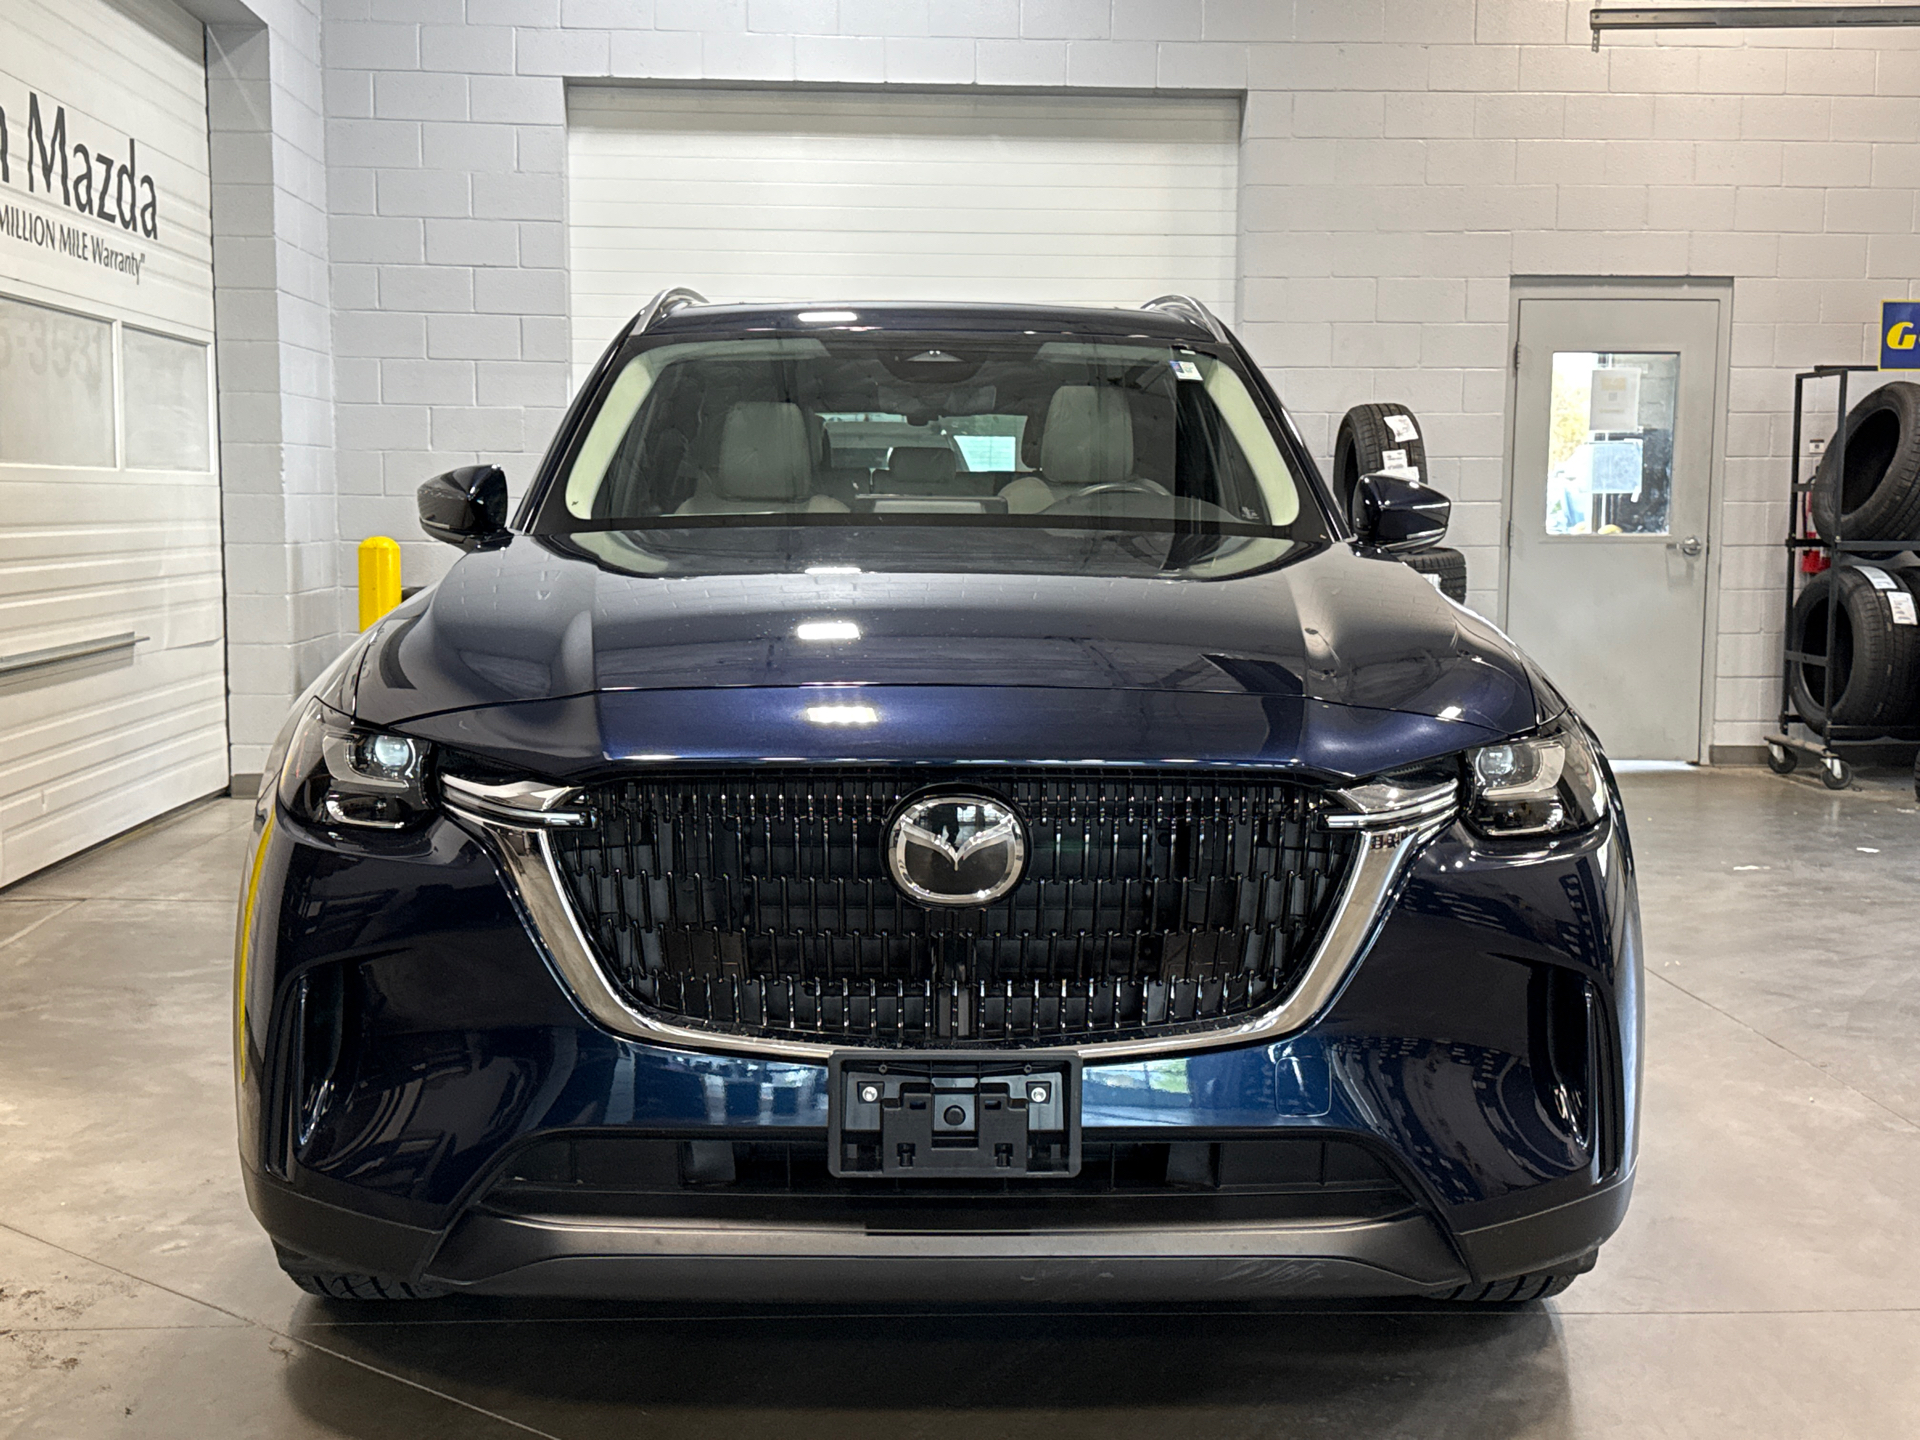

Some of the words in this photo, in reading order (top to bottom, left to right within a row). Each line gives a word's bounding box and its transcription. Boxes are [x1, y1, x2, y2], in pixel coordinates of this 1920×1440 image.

[27, 91, 158, 240] Mazda
[0, 204, 56, 251] MILLION
[59, 223, 89, 261] MILE
[1886, 321, 1920, 350] G
